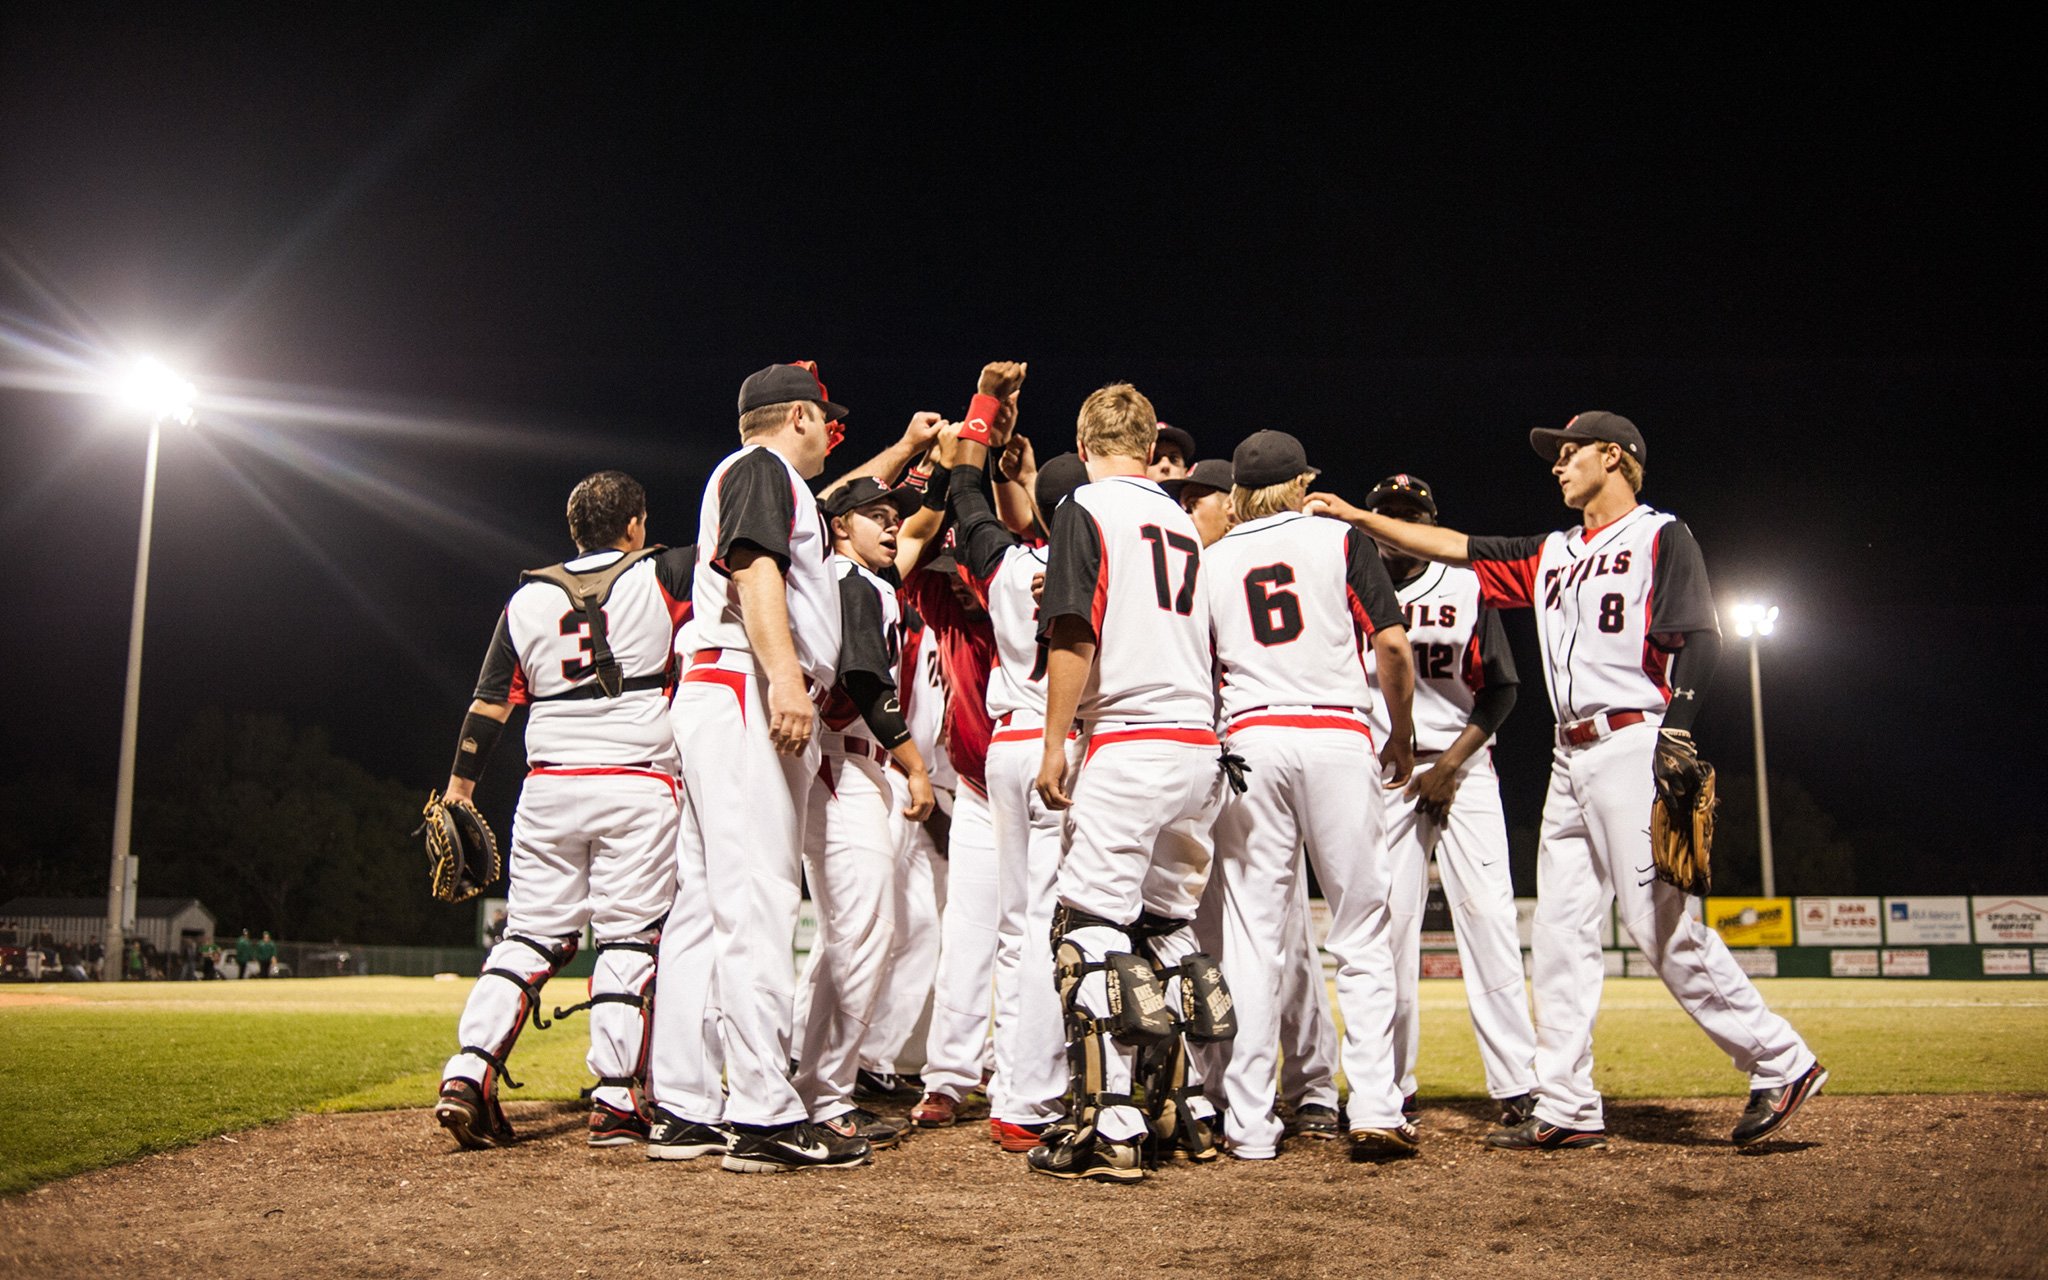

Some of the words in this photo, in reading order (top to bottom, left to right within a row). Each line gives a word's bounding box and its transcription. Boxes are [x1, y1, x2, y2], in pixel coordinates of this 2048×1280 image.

[1139, 523, 1201, 617] 17
[1243, 561, 1305, 648] 6
[1400, 603, 1457, 629] ILS
[1598, 592, 1625, 634] 8
[559, 607, 610, 683] 3
[1413, 642, 1454, 680] 12
[1833, 917, 1877, 928] EVERS
[1838, 903, 1866, 914] DAN
